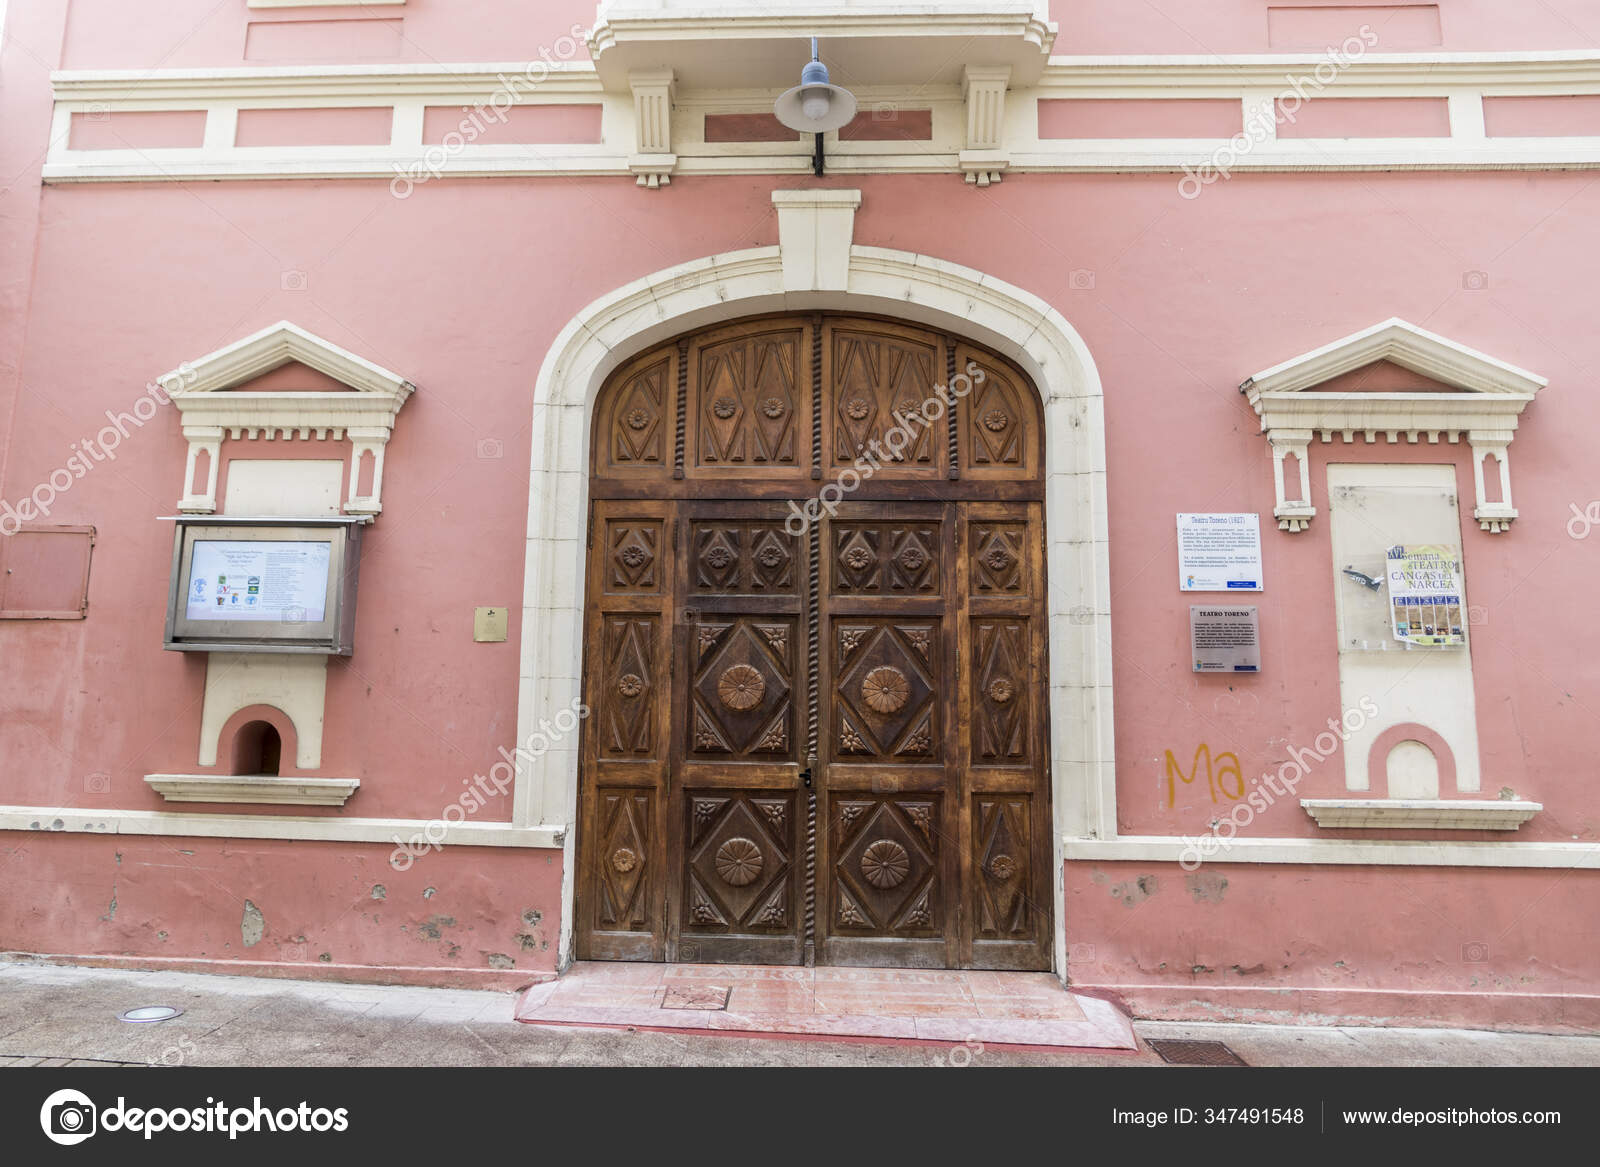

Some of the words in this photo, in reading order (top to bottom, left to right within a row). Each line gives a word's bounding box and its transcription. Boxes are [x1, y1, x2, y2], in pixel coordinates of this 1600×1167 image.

[1402, 552, 1440, 561] Semana
[1412, 560, 1455, 570] TEATRO
[1391, 571, 1436, 580] CANGAS
[1408, 580, 1455, 589] NARCEA
[1165, 743, 1245, 809] Ma
